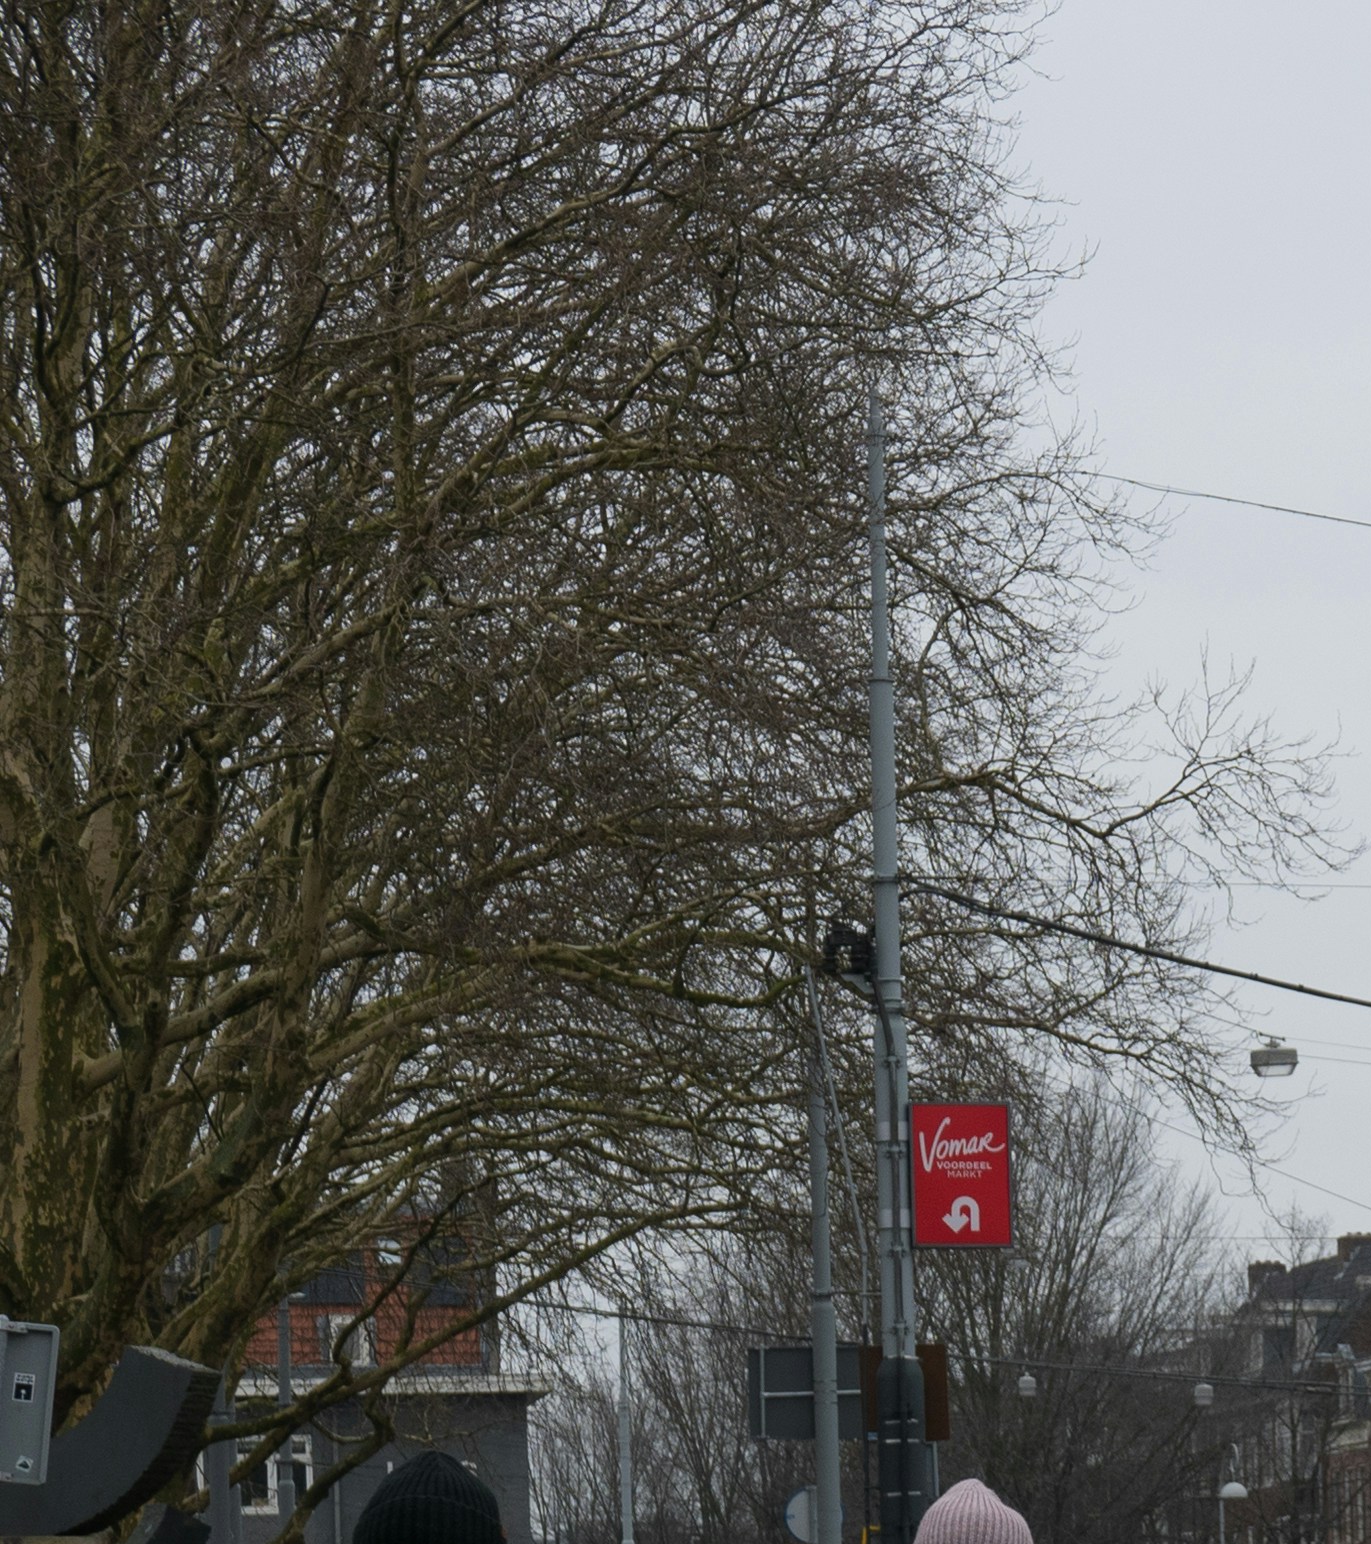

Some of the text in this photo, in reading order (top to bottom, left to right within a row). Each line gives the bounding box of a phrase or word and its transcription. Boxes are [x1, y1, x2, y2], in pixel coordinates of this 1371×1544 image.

[918, 1116, 1006, 1173] Vomar
[936, 1160, 993, 1170] VOORDEEL
[946, 1169, 983, 1178] MARKT
